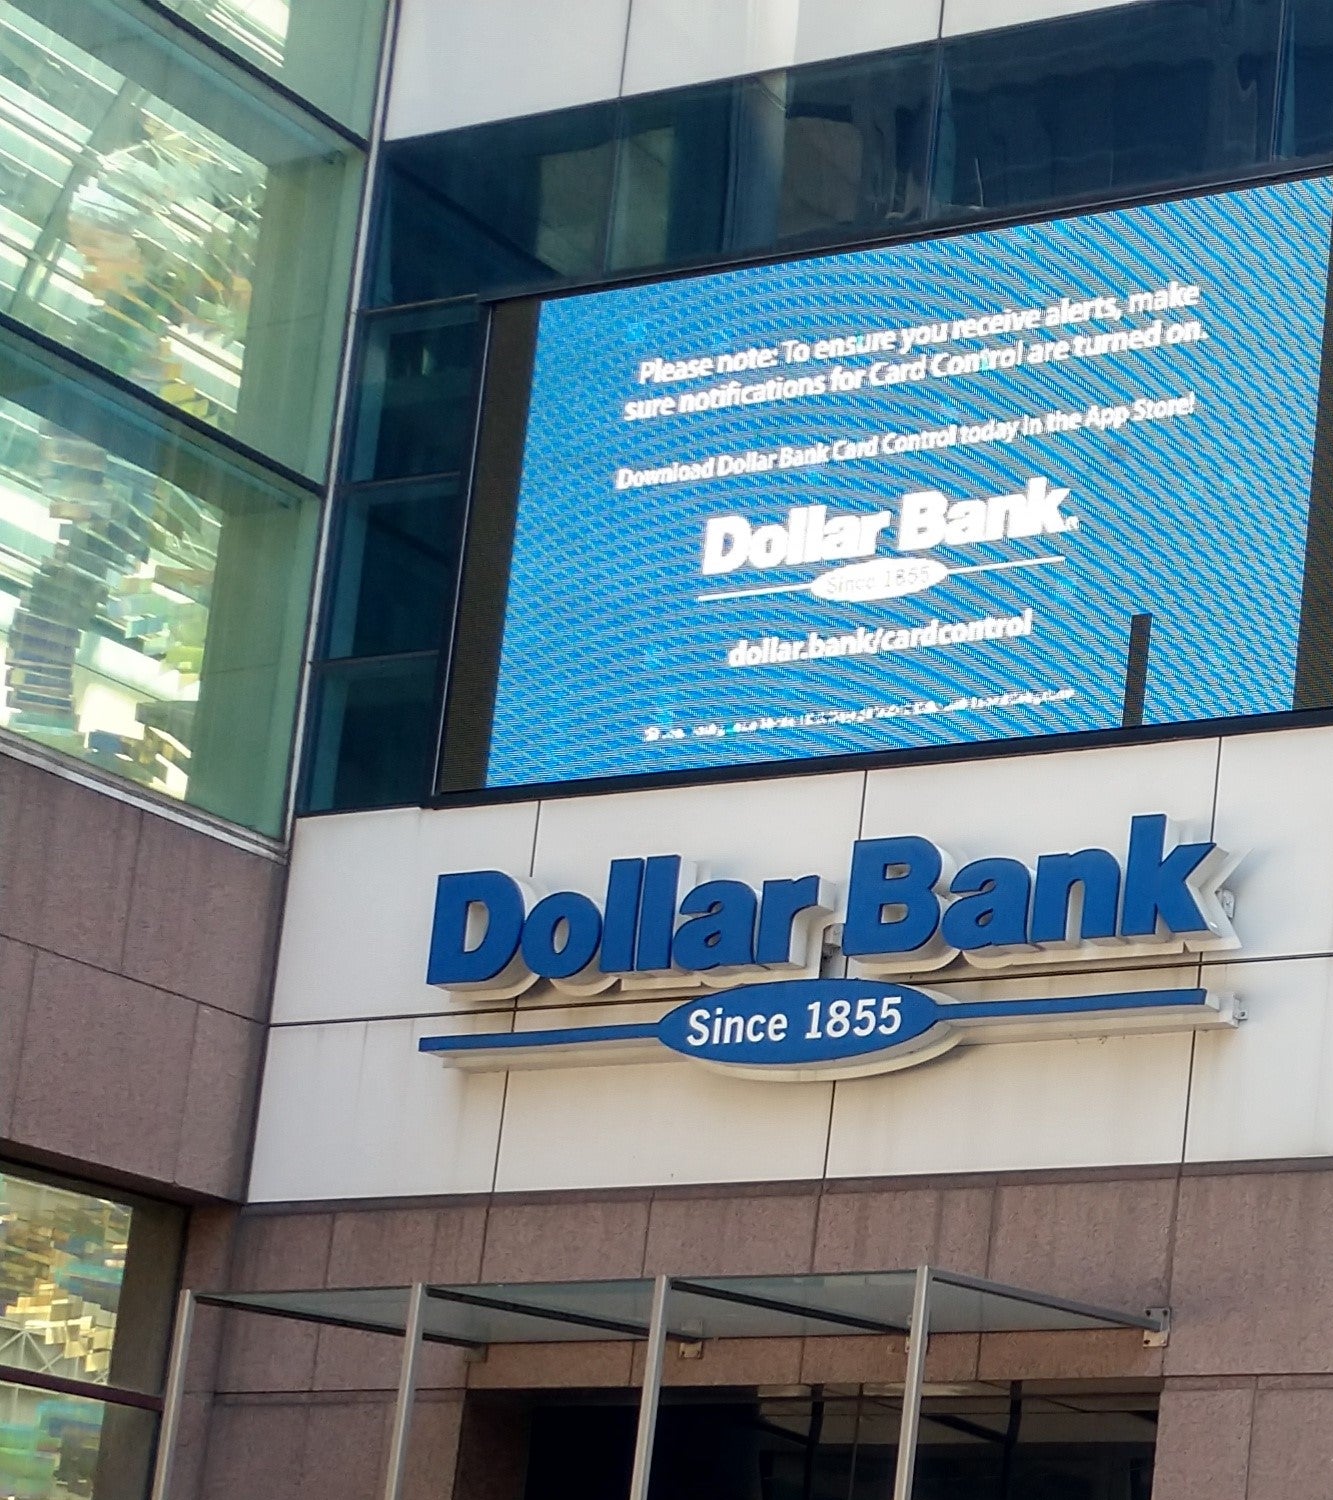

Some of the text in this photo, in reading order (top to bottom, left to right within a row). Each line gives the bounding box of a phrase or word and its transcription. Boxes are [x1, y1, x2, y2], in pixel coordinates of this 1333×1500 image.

[624, 319, 1210, 421] sure notifications for Card Control are turned on.
[639, 281, 1201, 384] Please note: To ensure you receive alerts, make
[615, 457, 716, 490] Download
[716, 451, 778, 481] Dollar
[778, 442, 831, 469] Bank
[832, 435, 879, 461] Card
[882, 424, 957, 454] Control
[960, 419, 1020, 444] today
[1045, 409, 1082, 433] the
[1084, 404, 1130, 431] App
[1133, 391, 1196, 421] Store!
[702, 476, 1071, 575] Dollar Bank
[728, 607, 1034, 668] dollar.bank/cardcontrol
[426, 812, 1219, 987] Dollar Bank
[686, 995, 904, 1048] Since 1855
